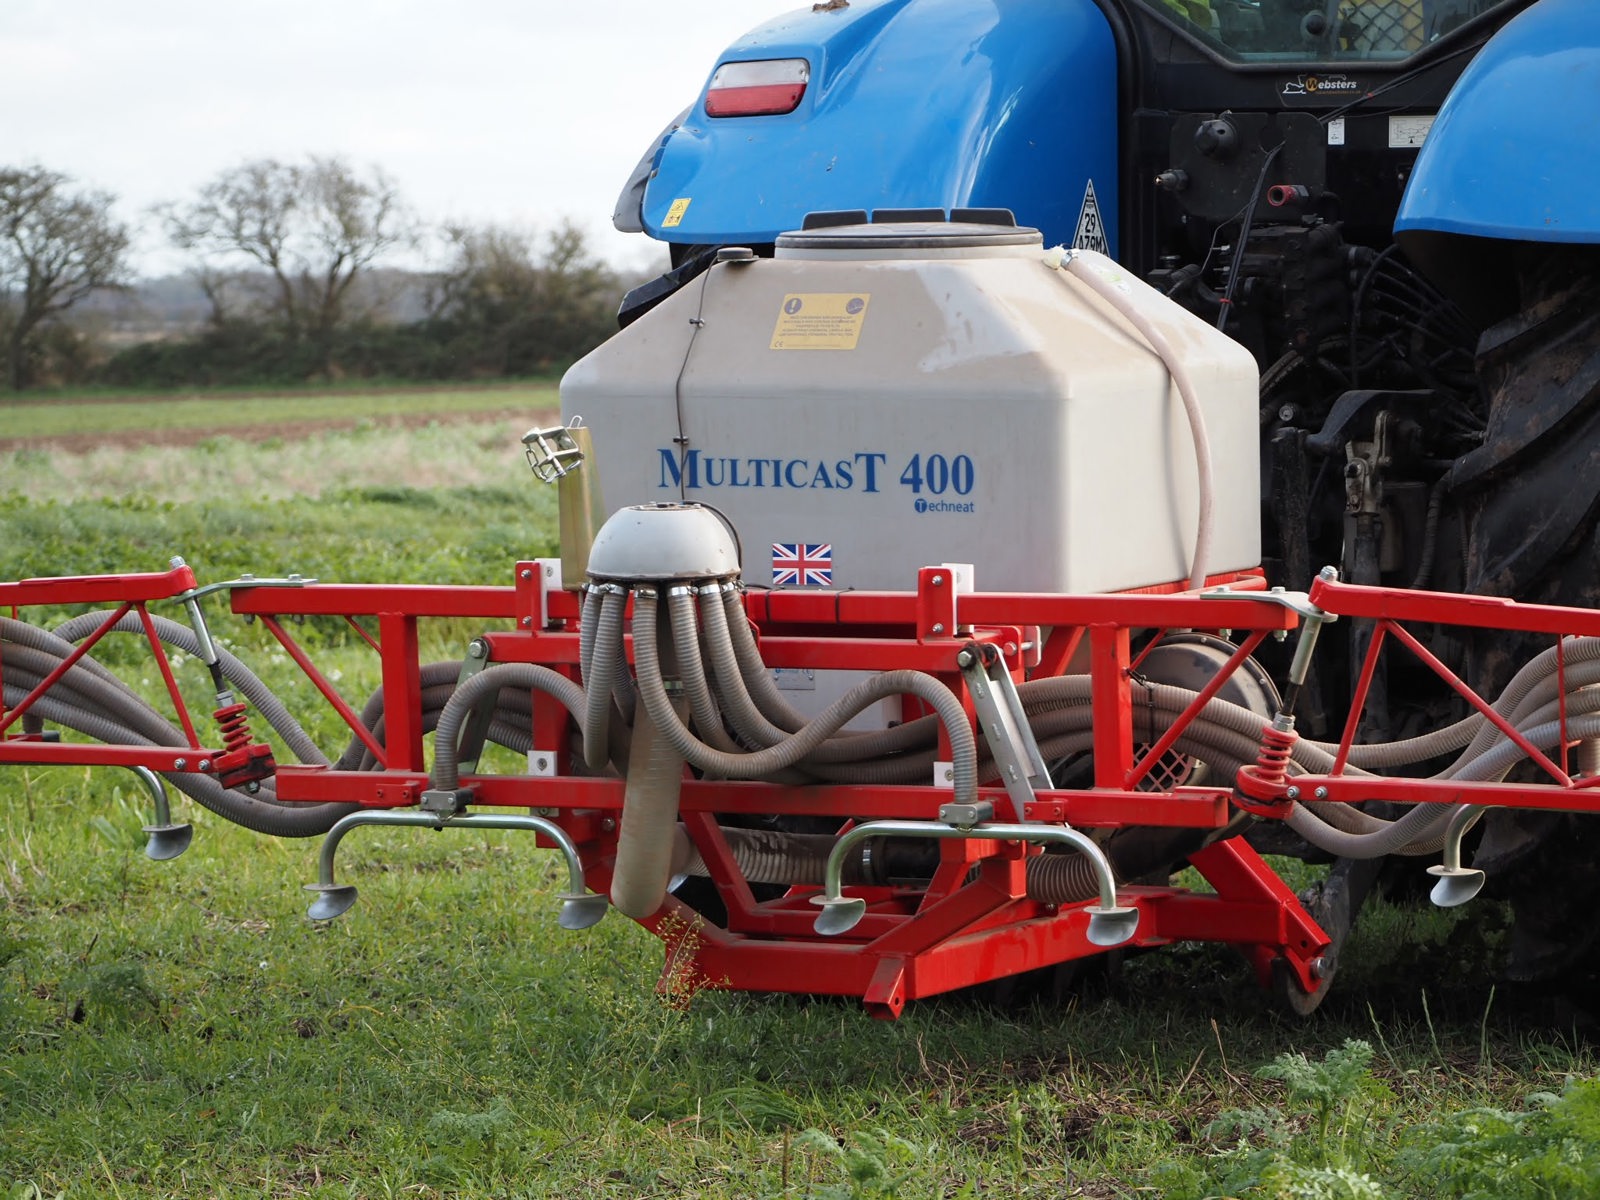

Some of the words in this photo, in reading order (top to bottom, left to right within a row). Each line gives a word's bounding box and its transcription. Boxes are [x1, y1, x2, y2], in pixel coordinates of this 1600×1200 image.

[1306, 78, 1357, 91] Websters
[1084, 213, 1096, 234] 29
[899, 453, 975, 495] 400
[914, 498, 975, 514] Techneat
